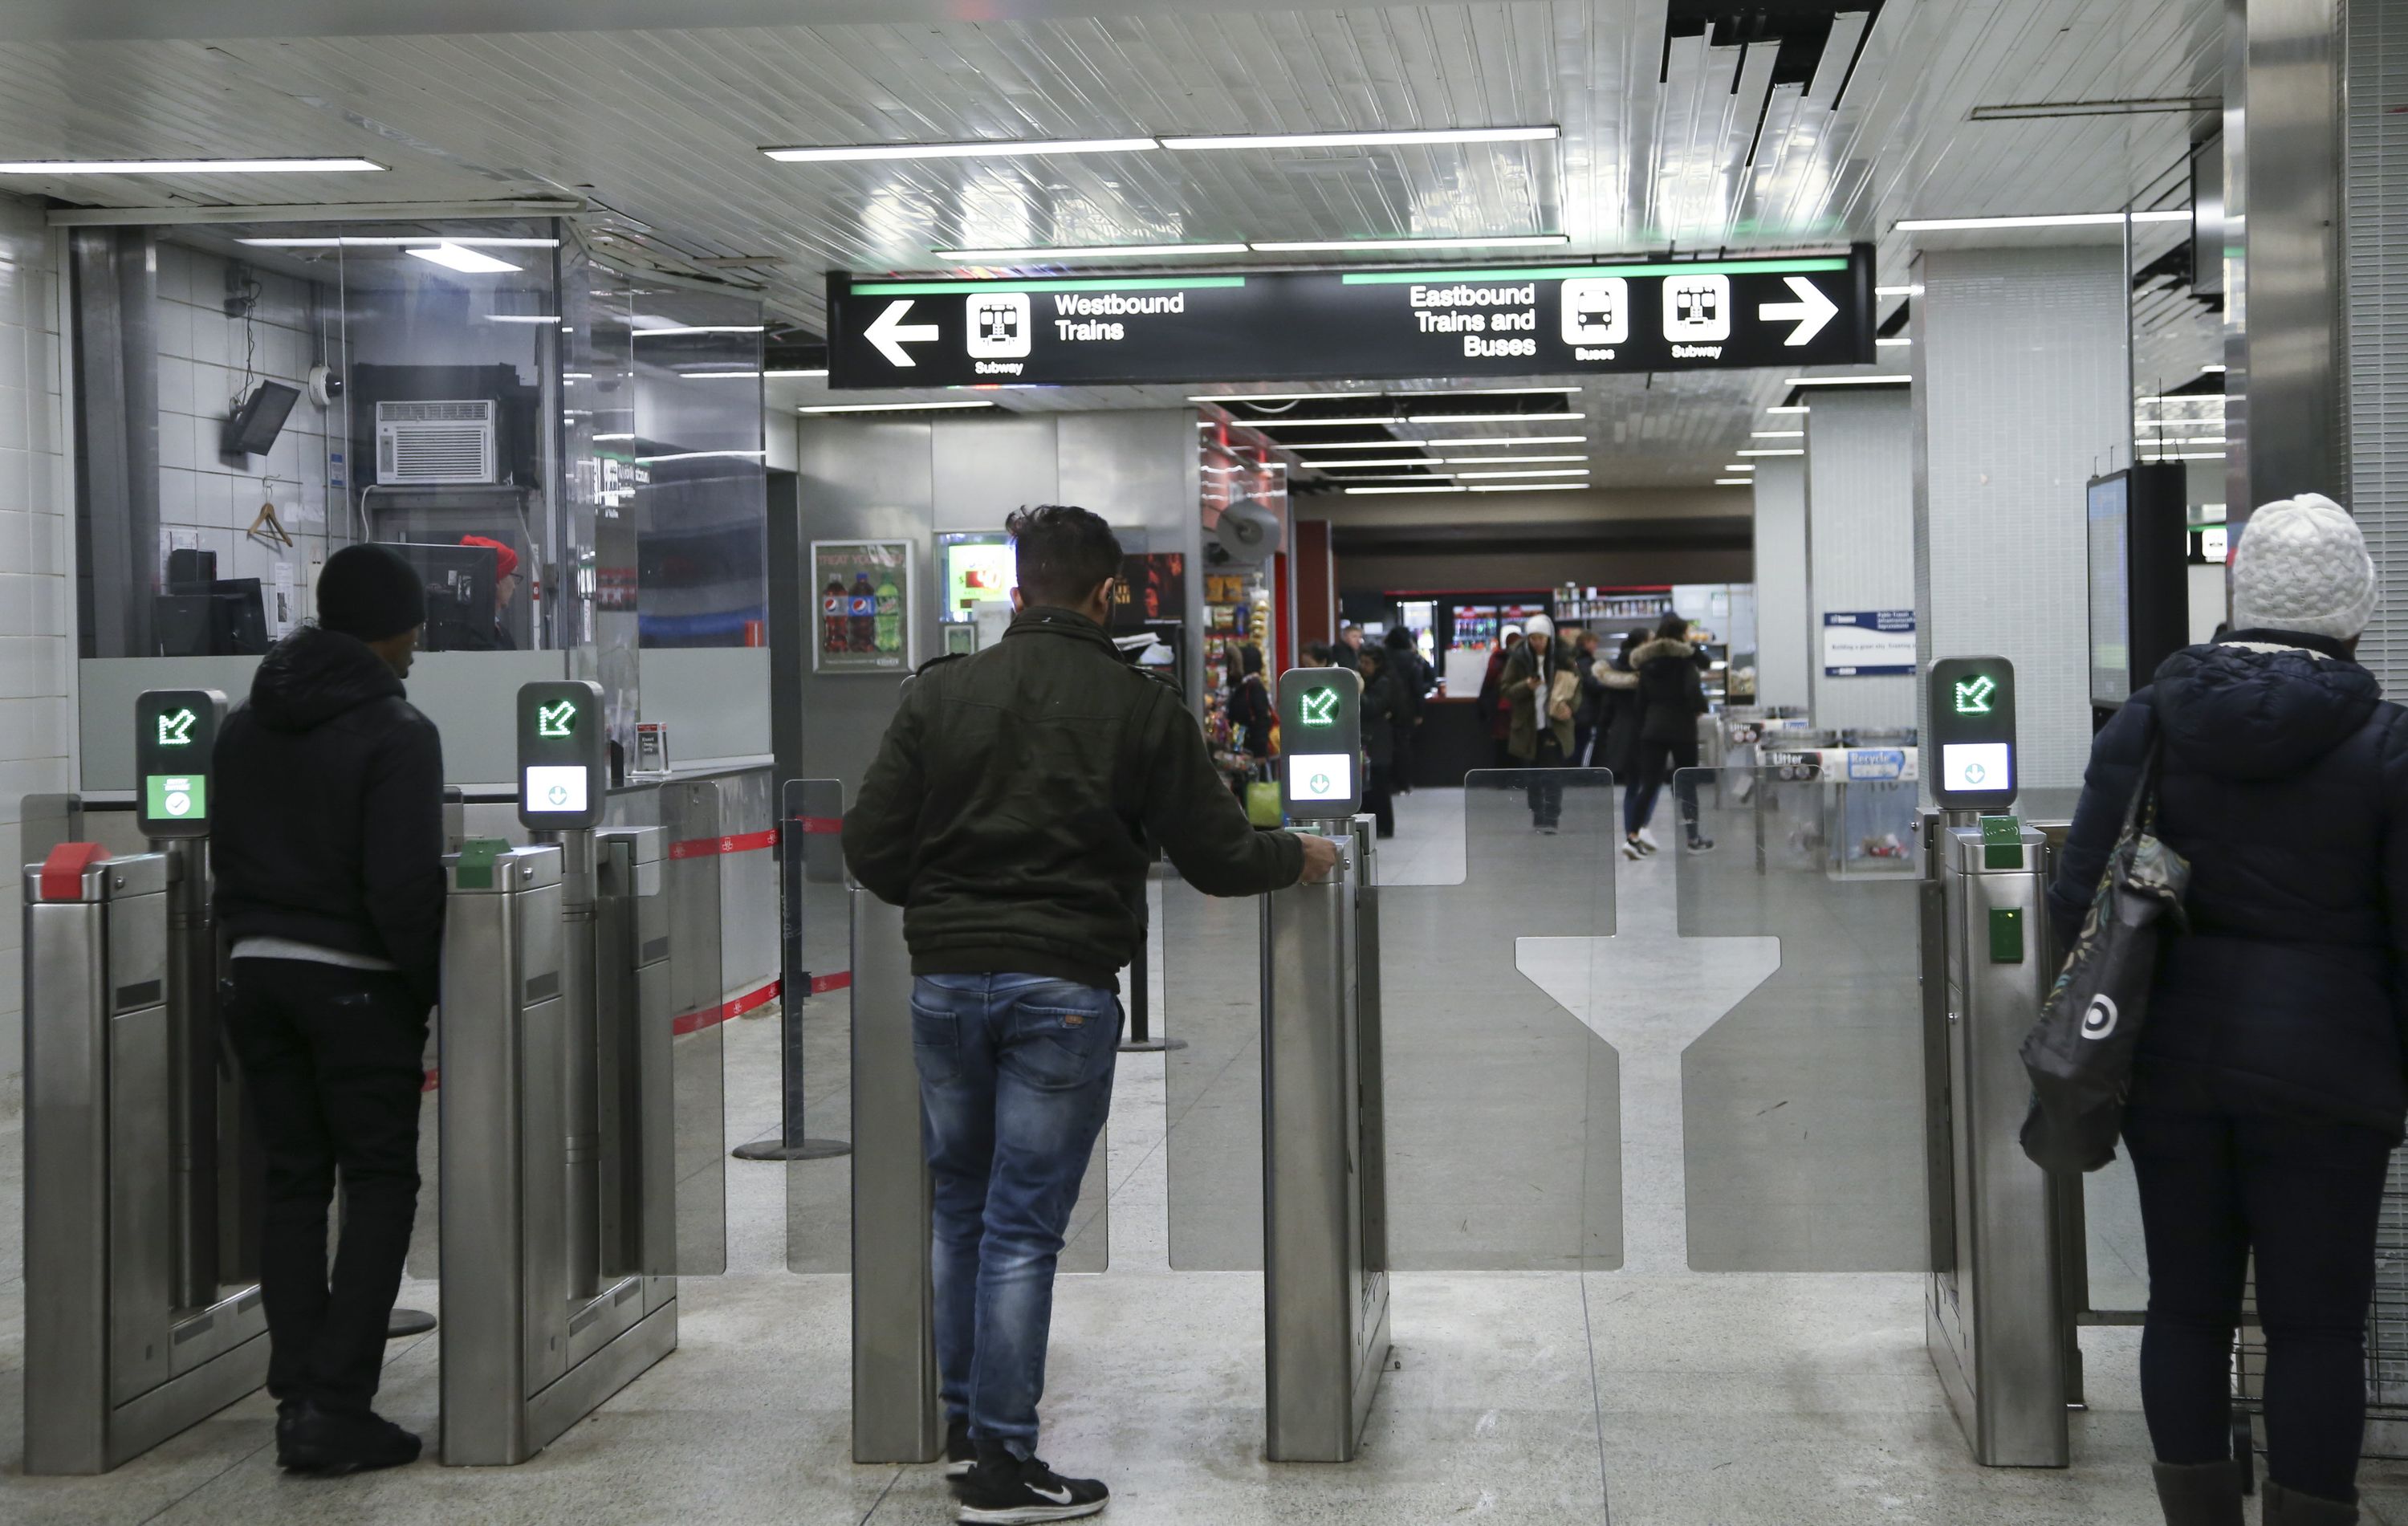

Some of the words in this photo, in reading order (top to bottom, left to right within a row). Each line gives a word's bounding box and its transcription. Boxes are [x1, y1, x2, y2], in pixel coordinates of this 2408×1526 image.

[1054, 291, 1185, 315] Westbound
[1409, 283, 1536, 307] Eastbound
[1414, 310, 1486, 332] Trains
[1491, 307, 1536, 331] and
[1054, 319, 1125, 341] Trains
[1463, 335, 1536, 357] Buses
[1575, 347, 1615, 360] Buses
[1671, 344, 1723, 360] Subway
[974, 360, 1024, 376] Subway
[1729, 723, 1751, 732] Litter
[1772, 752, 1803, 765] Litter
